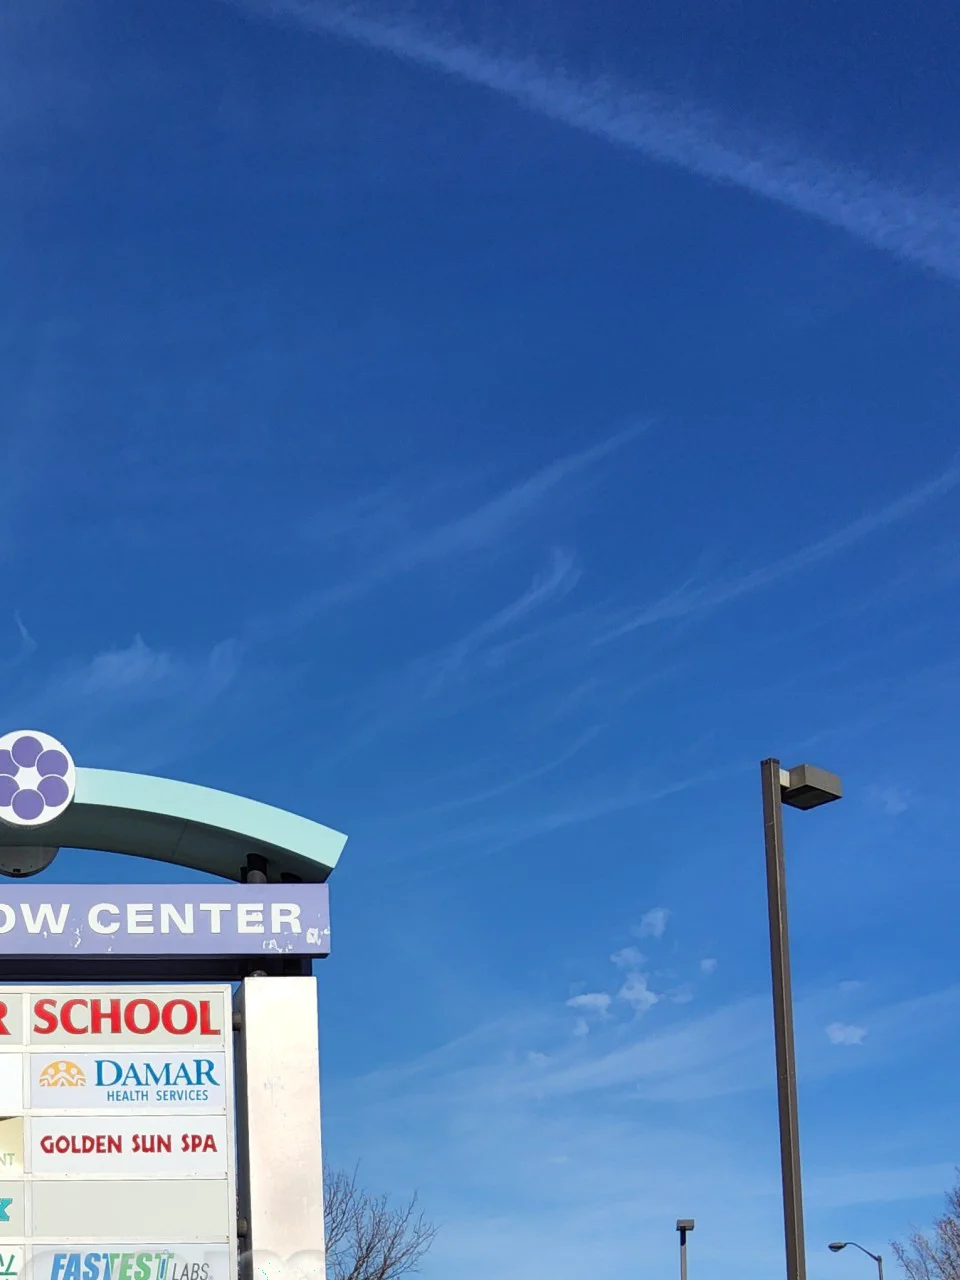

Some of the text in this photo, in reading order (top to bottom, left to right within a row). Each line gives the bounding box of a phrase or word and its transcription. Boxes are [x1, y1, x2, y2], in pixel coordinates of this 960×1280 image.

[87, 902, 302, 935] CENTER
[33, 998, 221, 1035] SCHOOL
[94, 1059, 220, 1087] DAMAR
[107, 1089, 209, 1101] HEALTH SERVICES
[40, 1133, 218, 1154] GOLDEN SUN SPA
